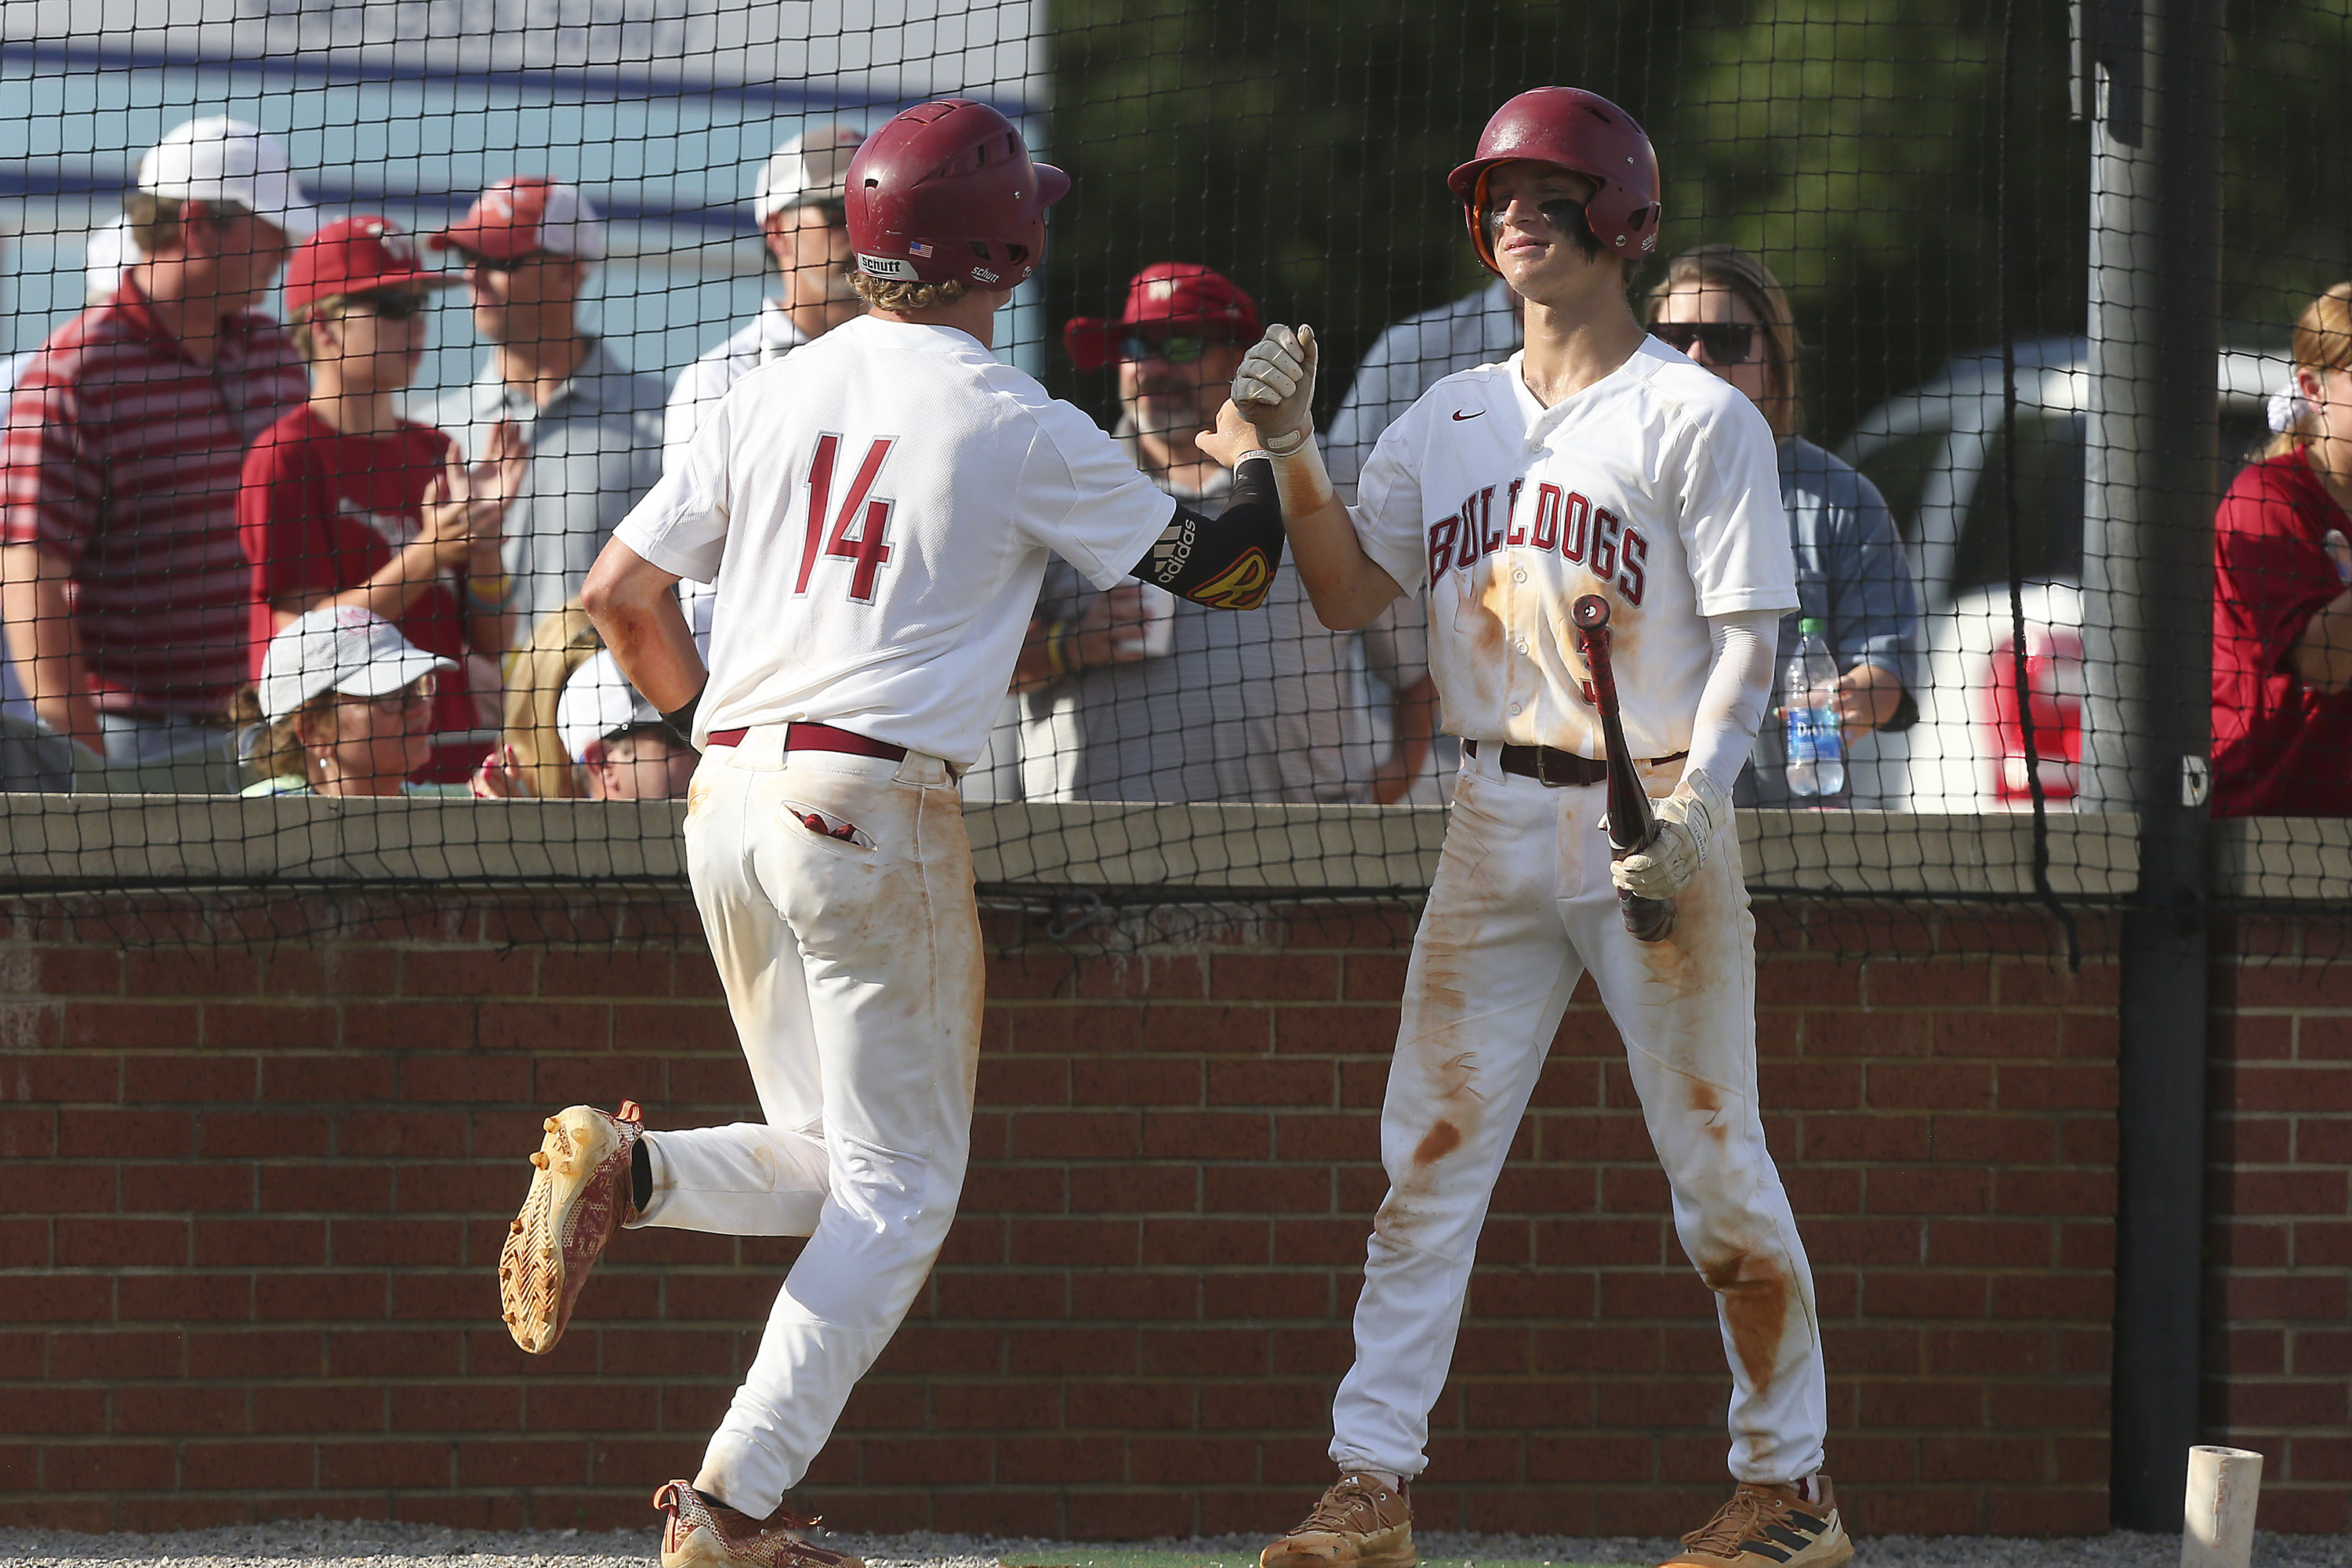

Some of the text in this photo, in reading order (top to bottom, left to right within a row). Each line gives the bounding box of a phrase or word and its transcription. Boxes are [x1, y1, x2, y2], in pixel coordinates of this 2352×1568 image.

[862, 256, 901, 273] schutt
[971, 267, 1000, 283] schutt
[791, 430, 899, 607] 14
[1428, 477, 1650, 609] BULLDOGS
[1158, 519, 1196, 583] adidas
